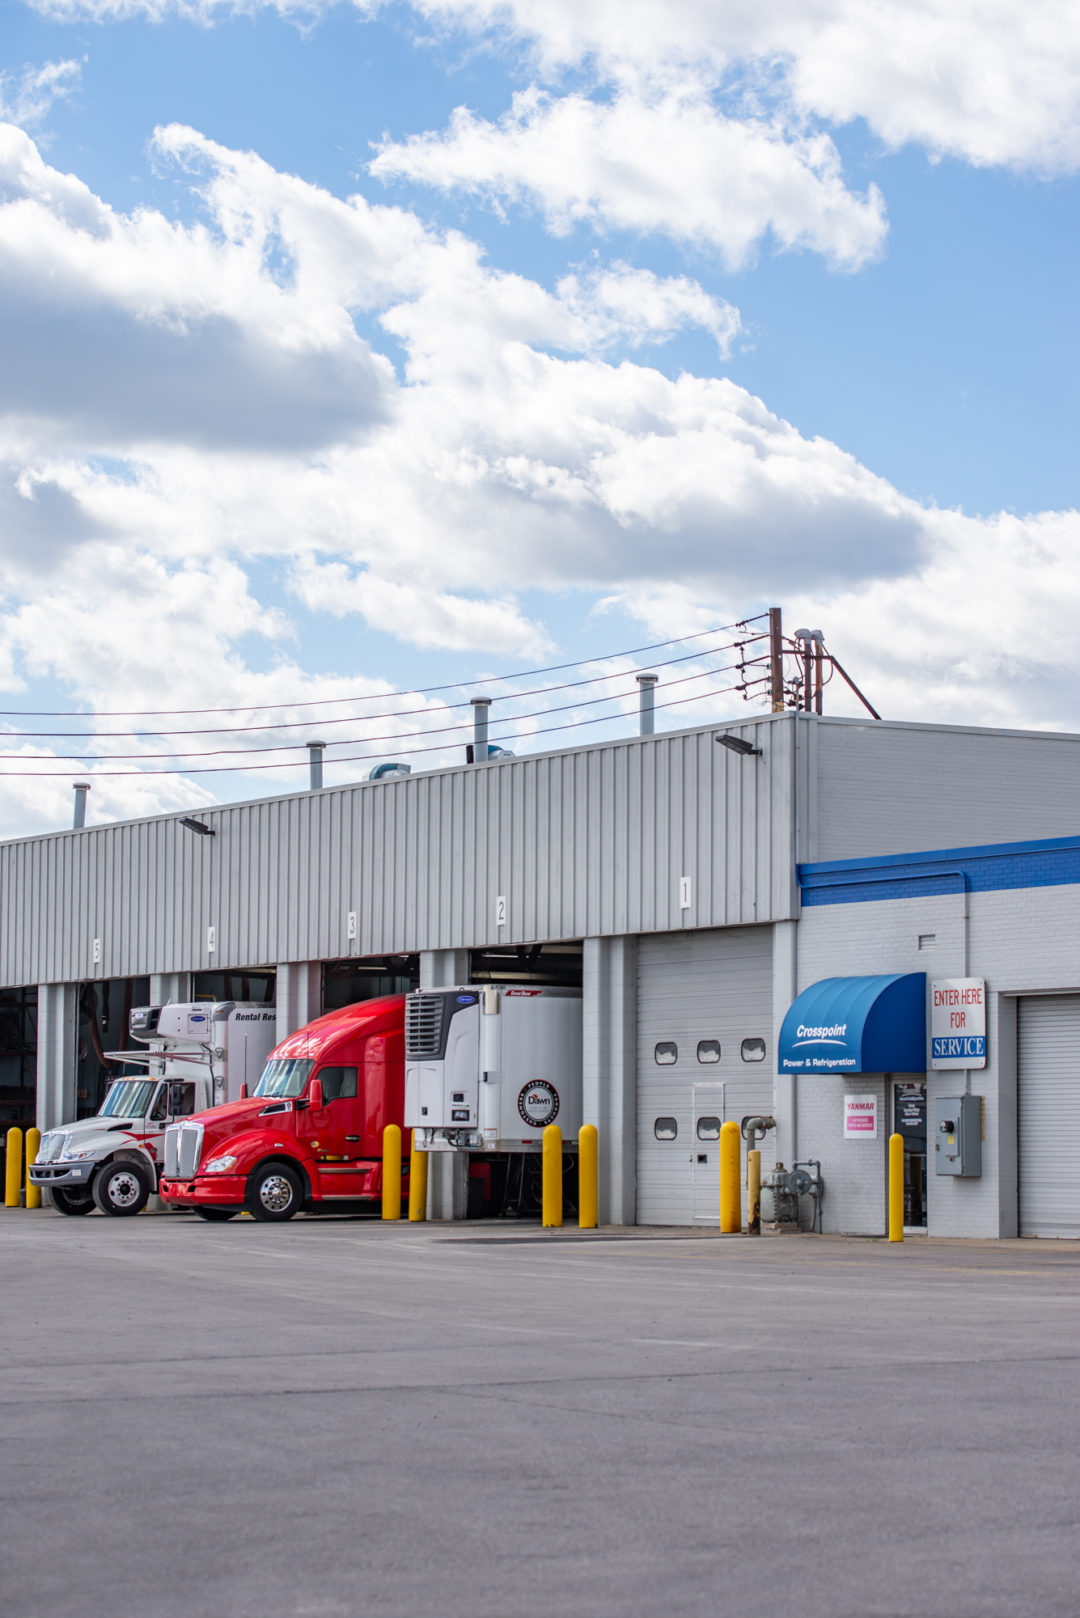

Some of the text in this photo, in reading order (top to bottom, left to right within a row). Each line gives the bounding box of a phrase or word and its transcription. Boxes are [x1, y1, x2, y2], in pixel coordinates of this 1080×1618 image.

[498, 900, 505, 921] 2
[349, 915, 356, 935] 3
[208, 929, 215, 949] 4
[94, 942, 100, 959] 5
[934, 986, 983, 1007] ENTER HERE
[235, 1012, 261, 1021] Rental
[950, 1011, 967, 1029] FOR
[796, 1023, 847, 1039] Crosspoint
[934, 1037, 985, 1056] SERVICE
[783, 1057, 856, 1068] Power & Refrigeration
[528, 1080, 551, 1089] PEOPLE
[528, 1096, 551, 1105] Dawn
[847, 1102, 875, 1111] YANMAR
